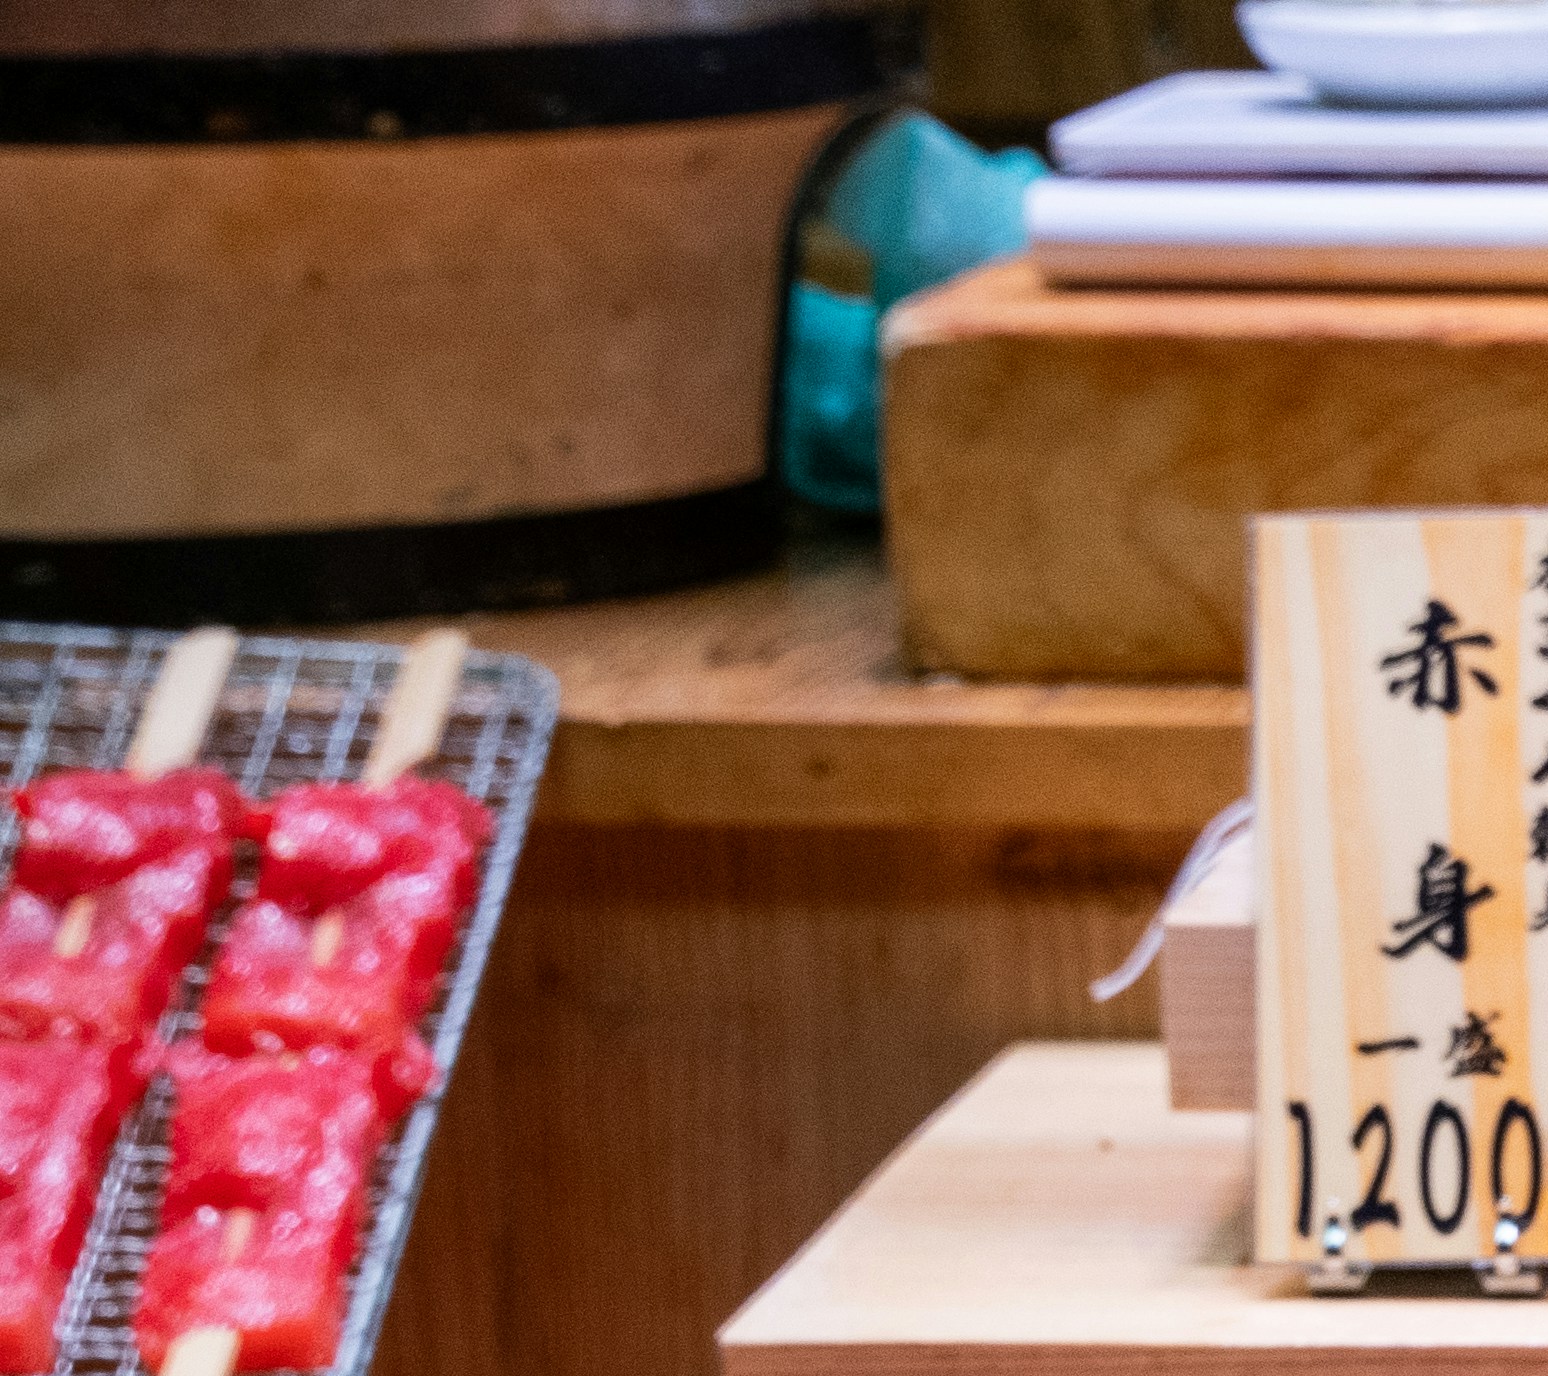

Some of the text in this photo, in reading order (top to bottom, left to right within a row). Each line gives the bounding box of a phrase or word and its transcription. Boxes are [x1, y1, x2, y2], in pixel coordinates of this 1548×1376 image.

[1383, 601, 1496, 962] 赤身
[1358, 1013, 1506, 1076] 一盛
[1290, 1098, 1542, 1237] 1200
